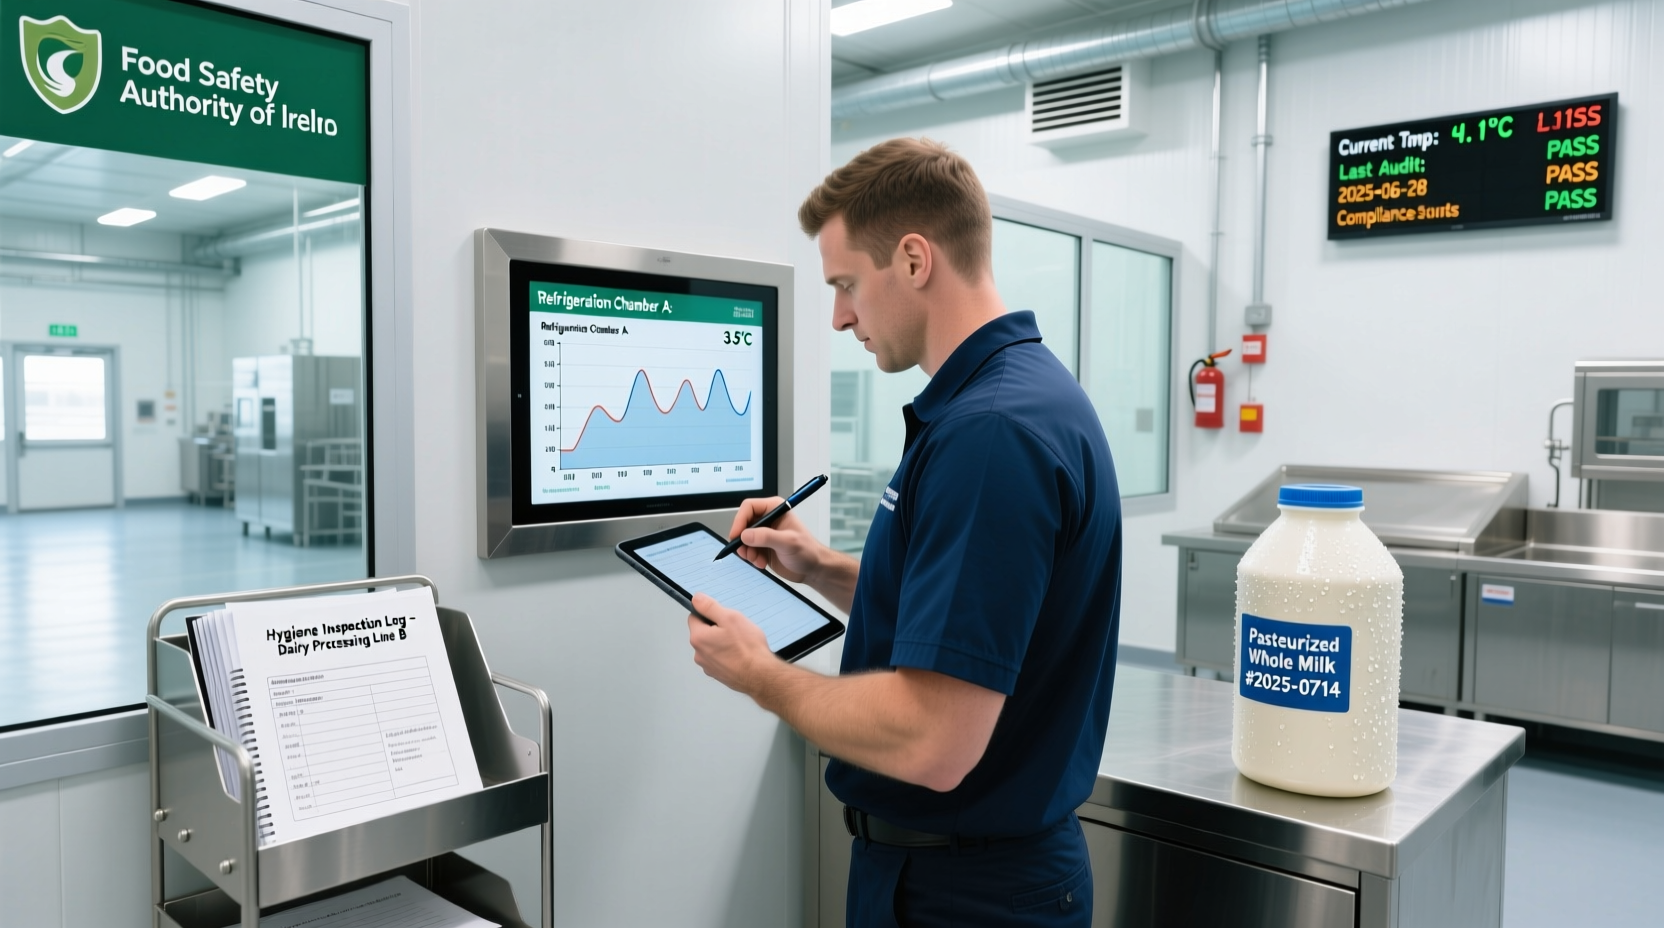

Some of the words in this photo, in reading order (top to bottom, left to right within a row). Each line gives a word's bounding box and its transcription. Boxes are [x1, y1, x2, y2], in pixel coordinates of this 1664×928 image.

[121, 46, 190, 82] Food
[199, 61, 279, 101] Safety
[119, 79, 243, 126] Authority
[250, 103, 275, 126] of
[1338, 134, 1395, 156] Current
[1547, 134, 1600, 160] PASS
[1339, 161, 1373, 180] Last
[1378, 156, 1426, 176] Audit:
[1546, 161, 1599, 184] PASS
[1338, 178, 1428, 203] 2025-06-28
[1545, 187, 1598, 210] PASS
[614, 296, 659, 312] Chamber
[278, 632, 310, 656] Dairy
[1249, 627, 1339, 652] Pasteurized
[1248, 647, 1293, 670] Whole
[1298, 655, 1336, 674] Milk
[1245, 670, 1341, 698] #2025-0714
